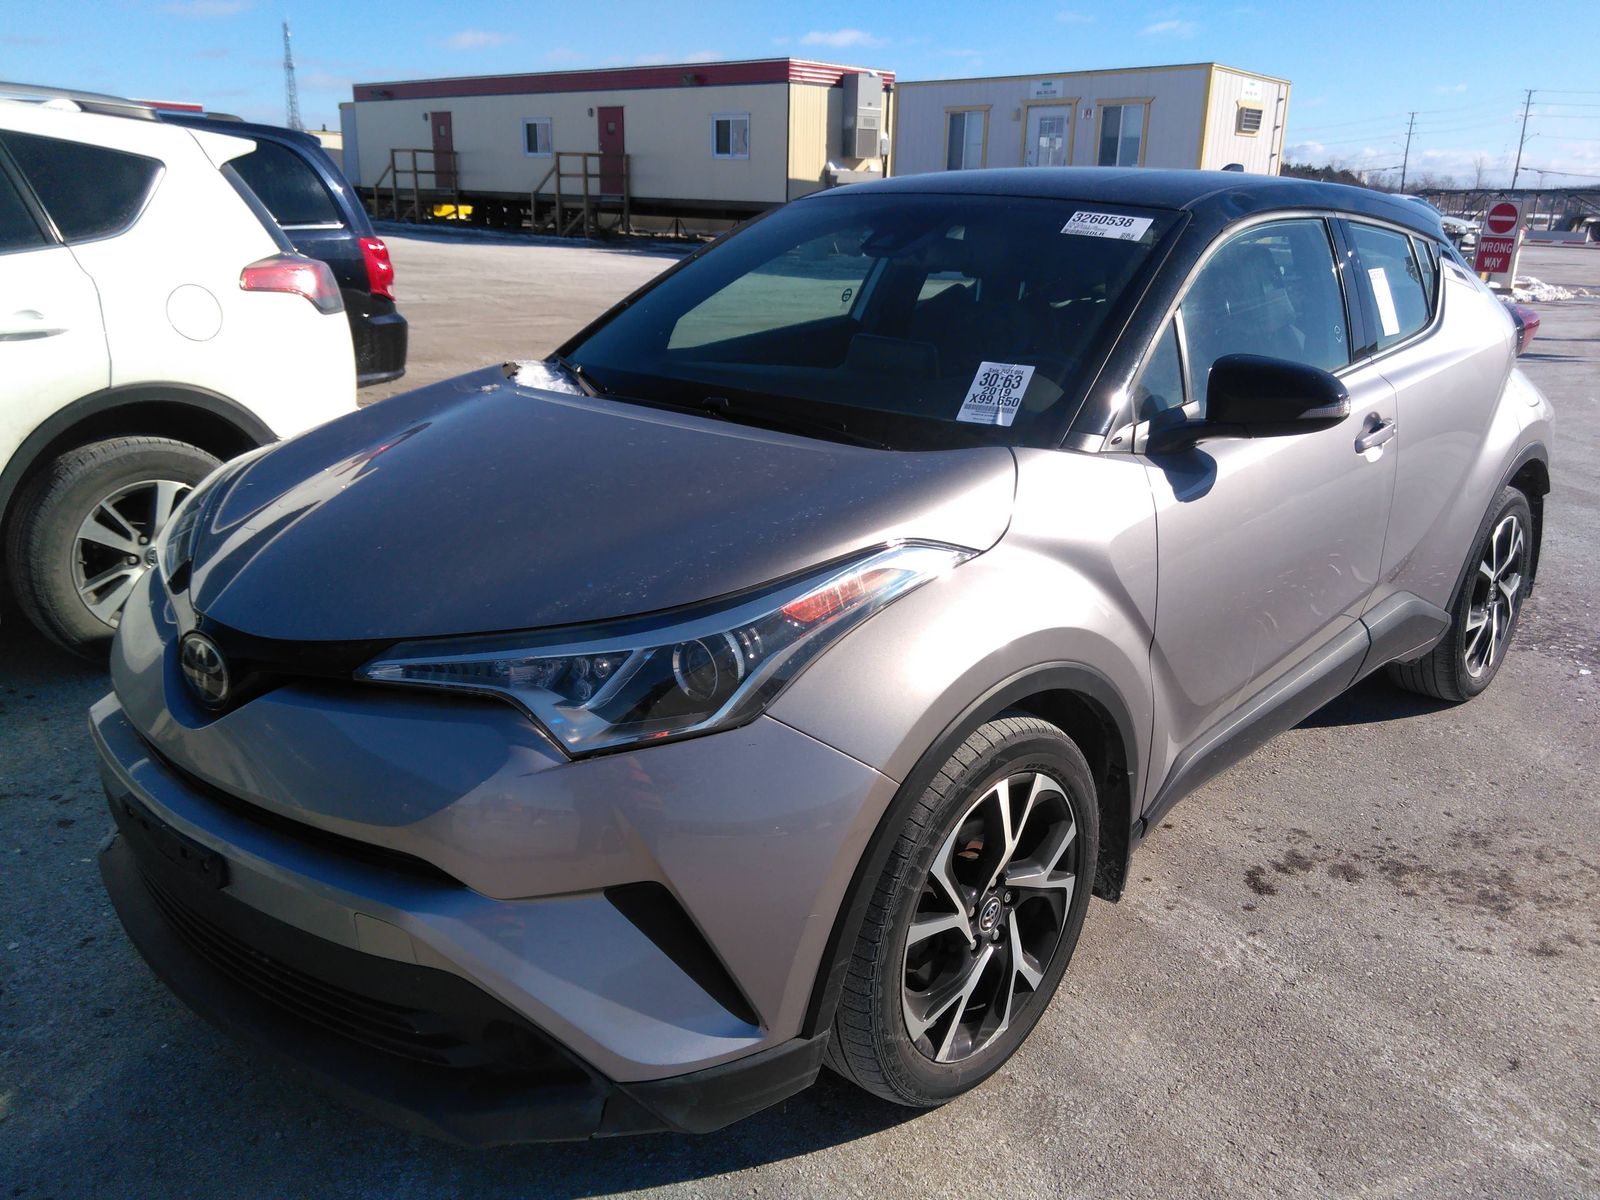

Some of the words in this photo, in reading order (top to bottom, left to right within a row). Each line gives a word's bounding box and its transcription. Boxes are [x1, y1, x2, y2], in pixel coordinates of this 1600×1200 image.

[1072, 212, 1135, 228] 3260538
[1480, 242, 1512, 254] WRONG
[1484, 257, 1502, 268] WAY
[979, 372, 1023, 389] 30:63
[981, 386, 1012, 397] 2019
